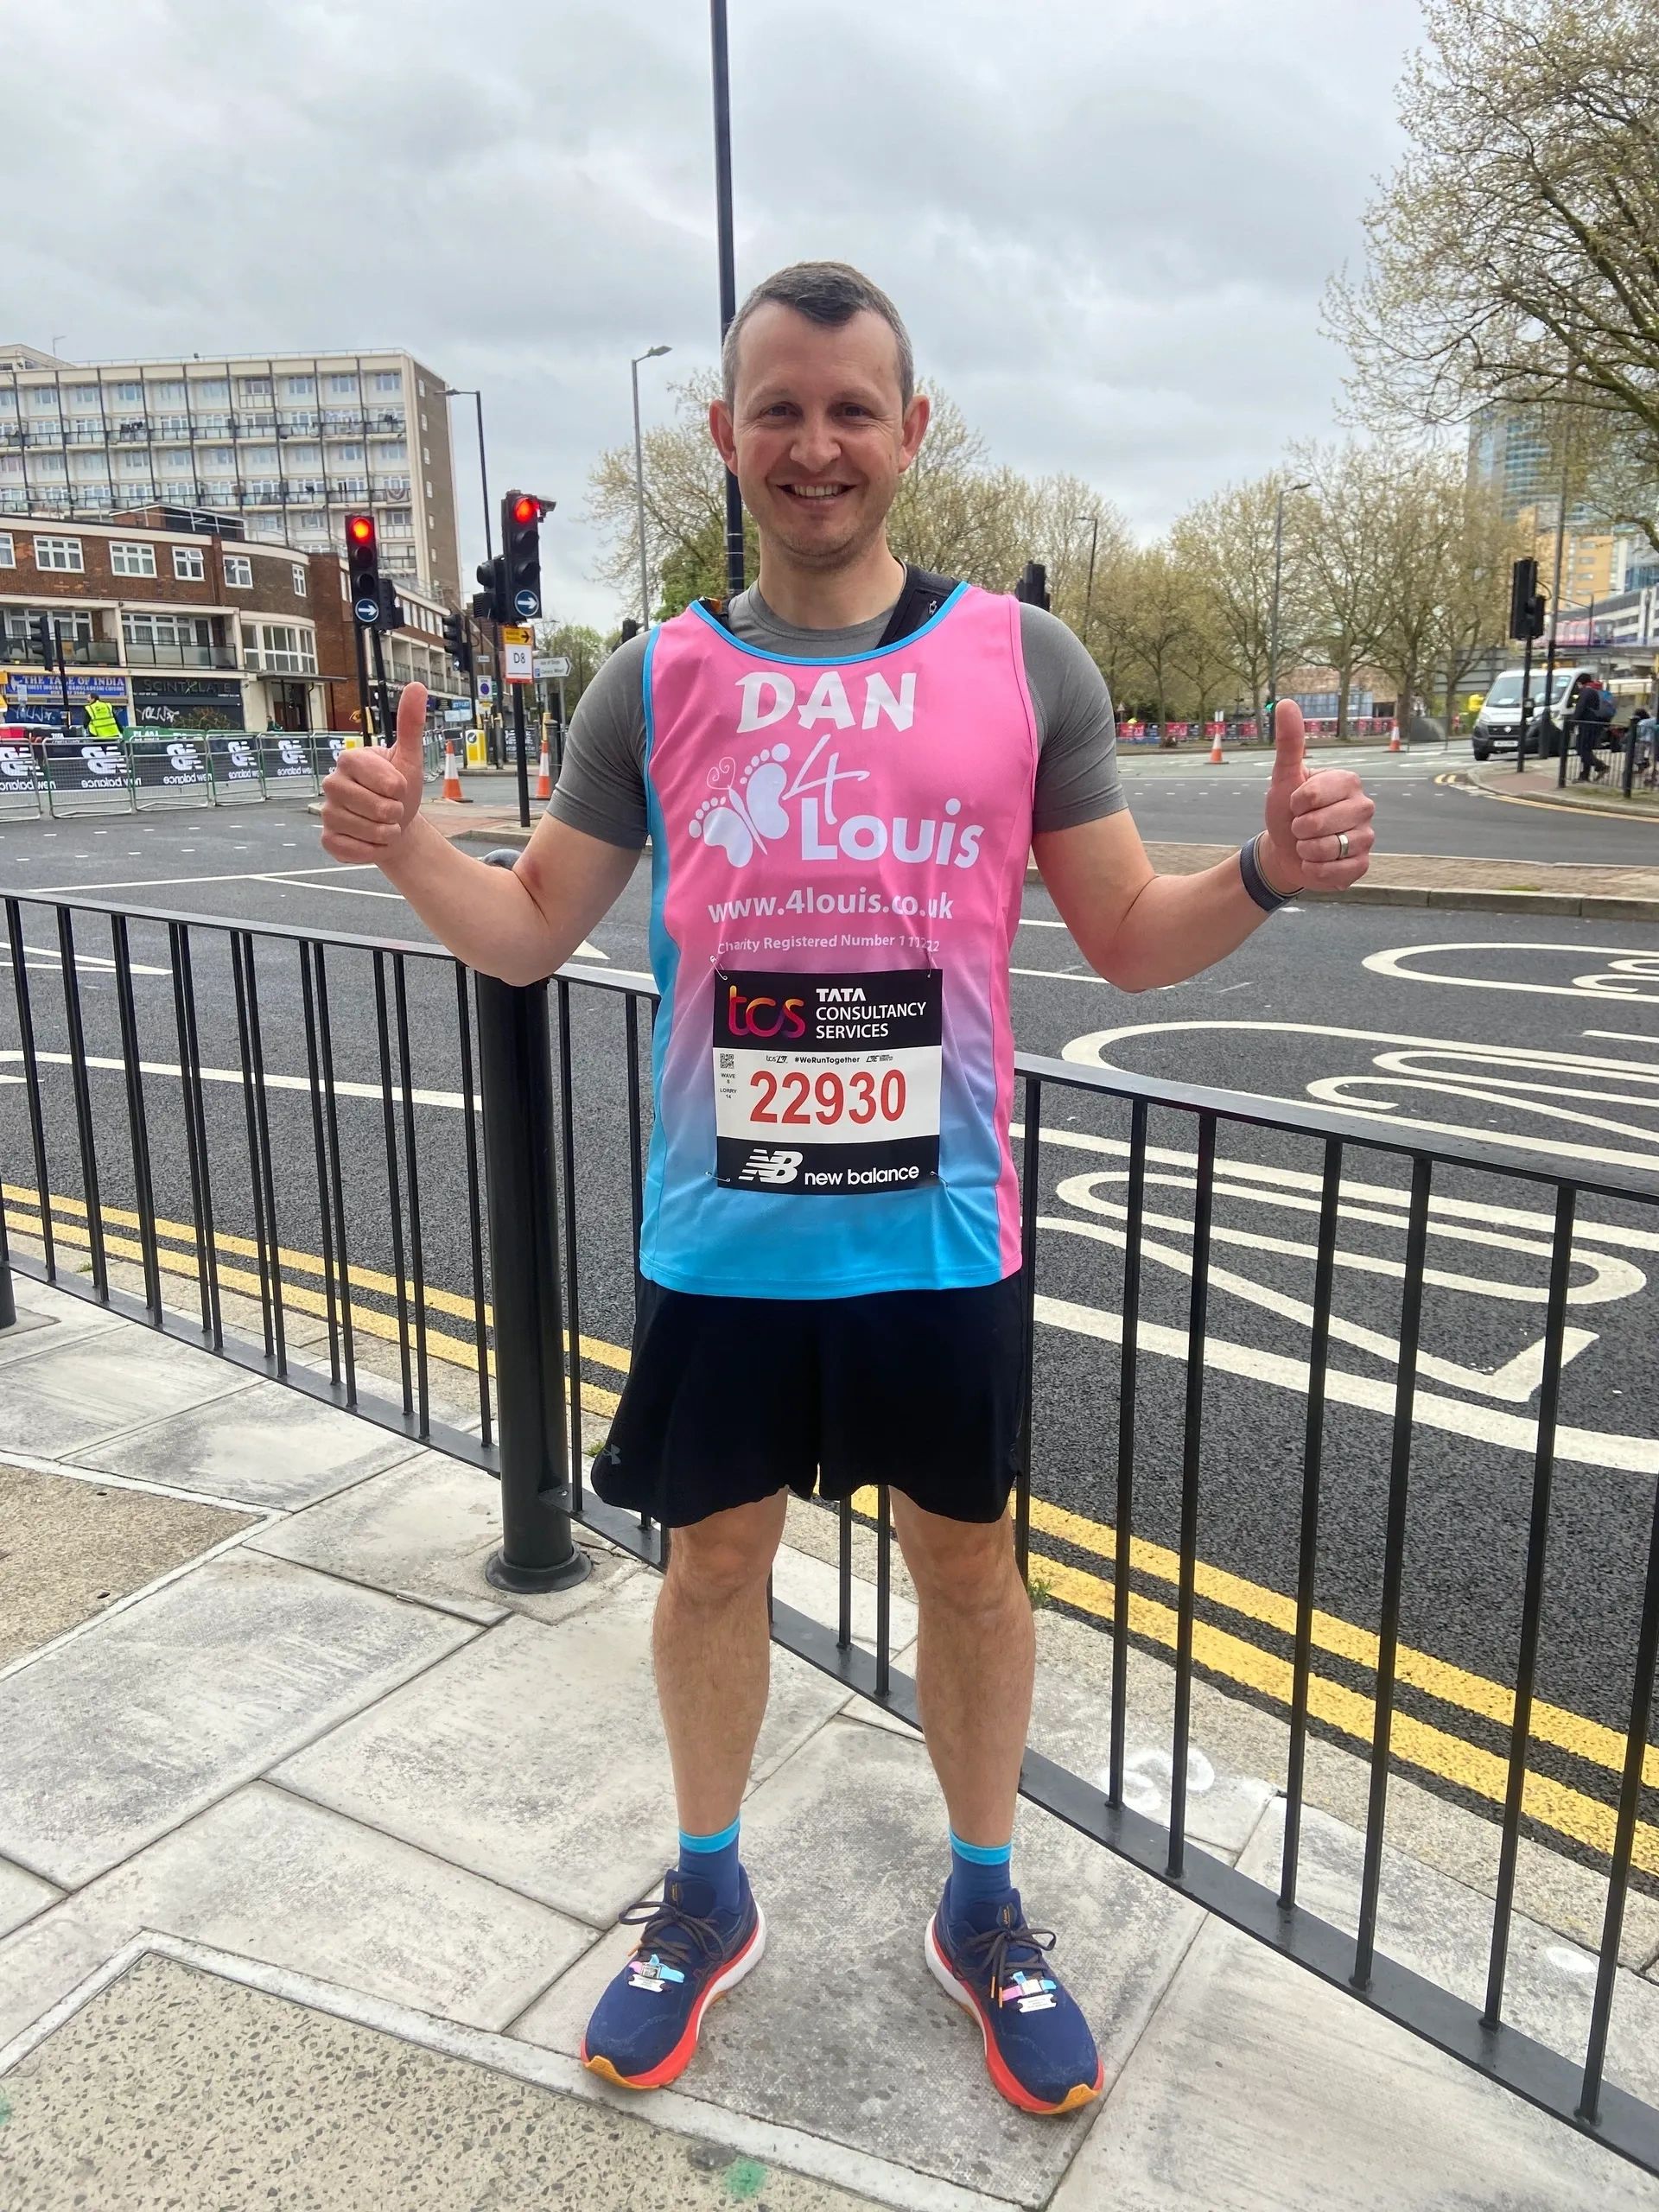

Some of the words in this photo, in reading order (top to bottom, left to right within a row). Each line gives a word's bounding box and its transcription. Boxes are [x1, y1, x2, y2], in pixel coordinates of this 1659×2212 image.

[513, 652, 526, 664] D8
[22, 675, 45, 684] THE
[48, 676, 75, 685] TAE
[77, 676, 91, 685] OF
[93, 677, 124, 686] INDIA
[734, 671, 917, 734] DAN
[781, 734, 870, 825] 4
[801, 798, 985, 869] Louis
[708, 887, 953, 924] www.4louis.co.uk
[717, 938, 760, 955] Charity
[764, 934, 837, 951] Registered
[841, 933, 894, 947] Number
[816, 988, 866, 1002] TATA
[728, 985, 806, 1039] tcs
[816, 1001, 926, 1021] CONSULTANCY
[816, 1023, 889, 1039] SERVICES
[794, 1056, 860, 1065] #WeRunTogether
[749, 1069, 906, 1125] 22930
[739, 1148, 804, 1185] NB
[804, 1169, 844, 1185] new
[847, 1164, 919, 1185] balance
